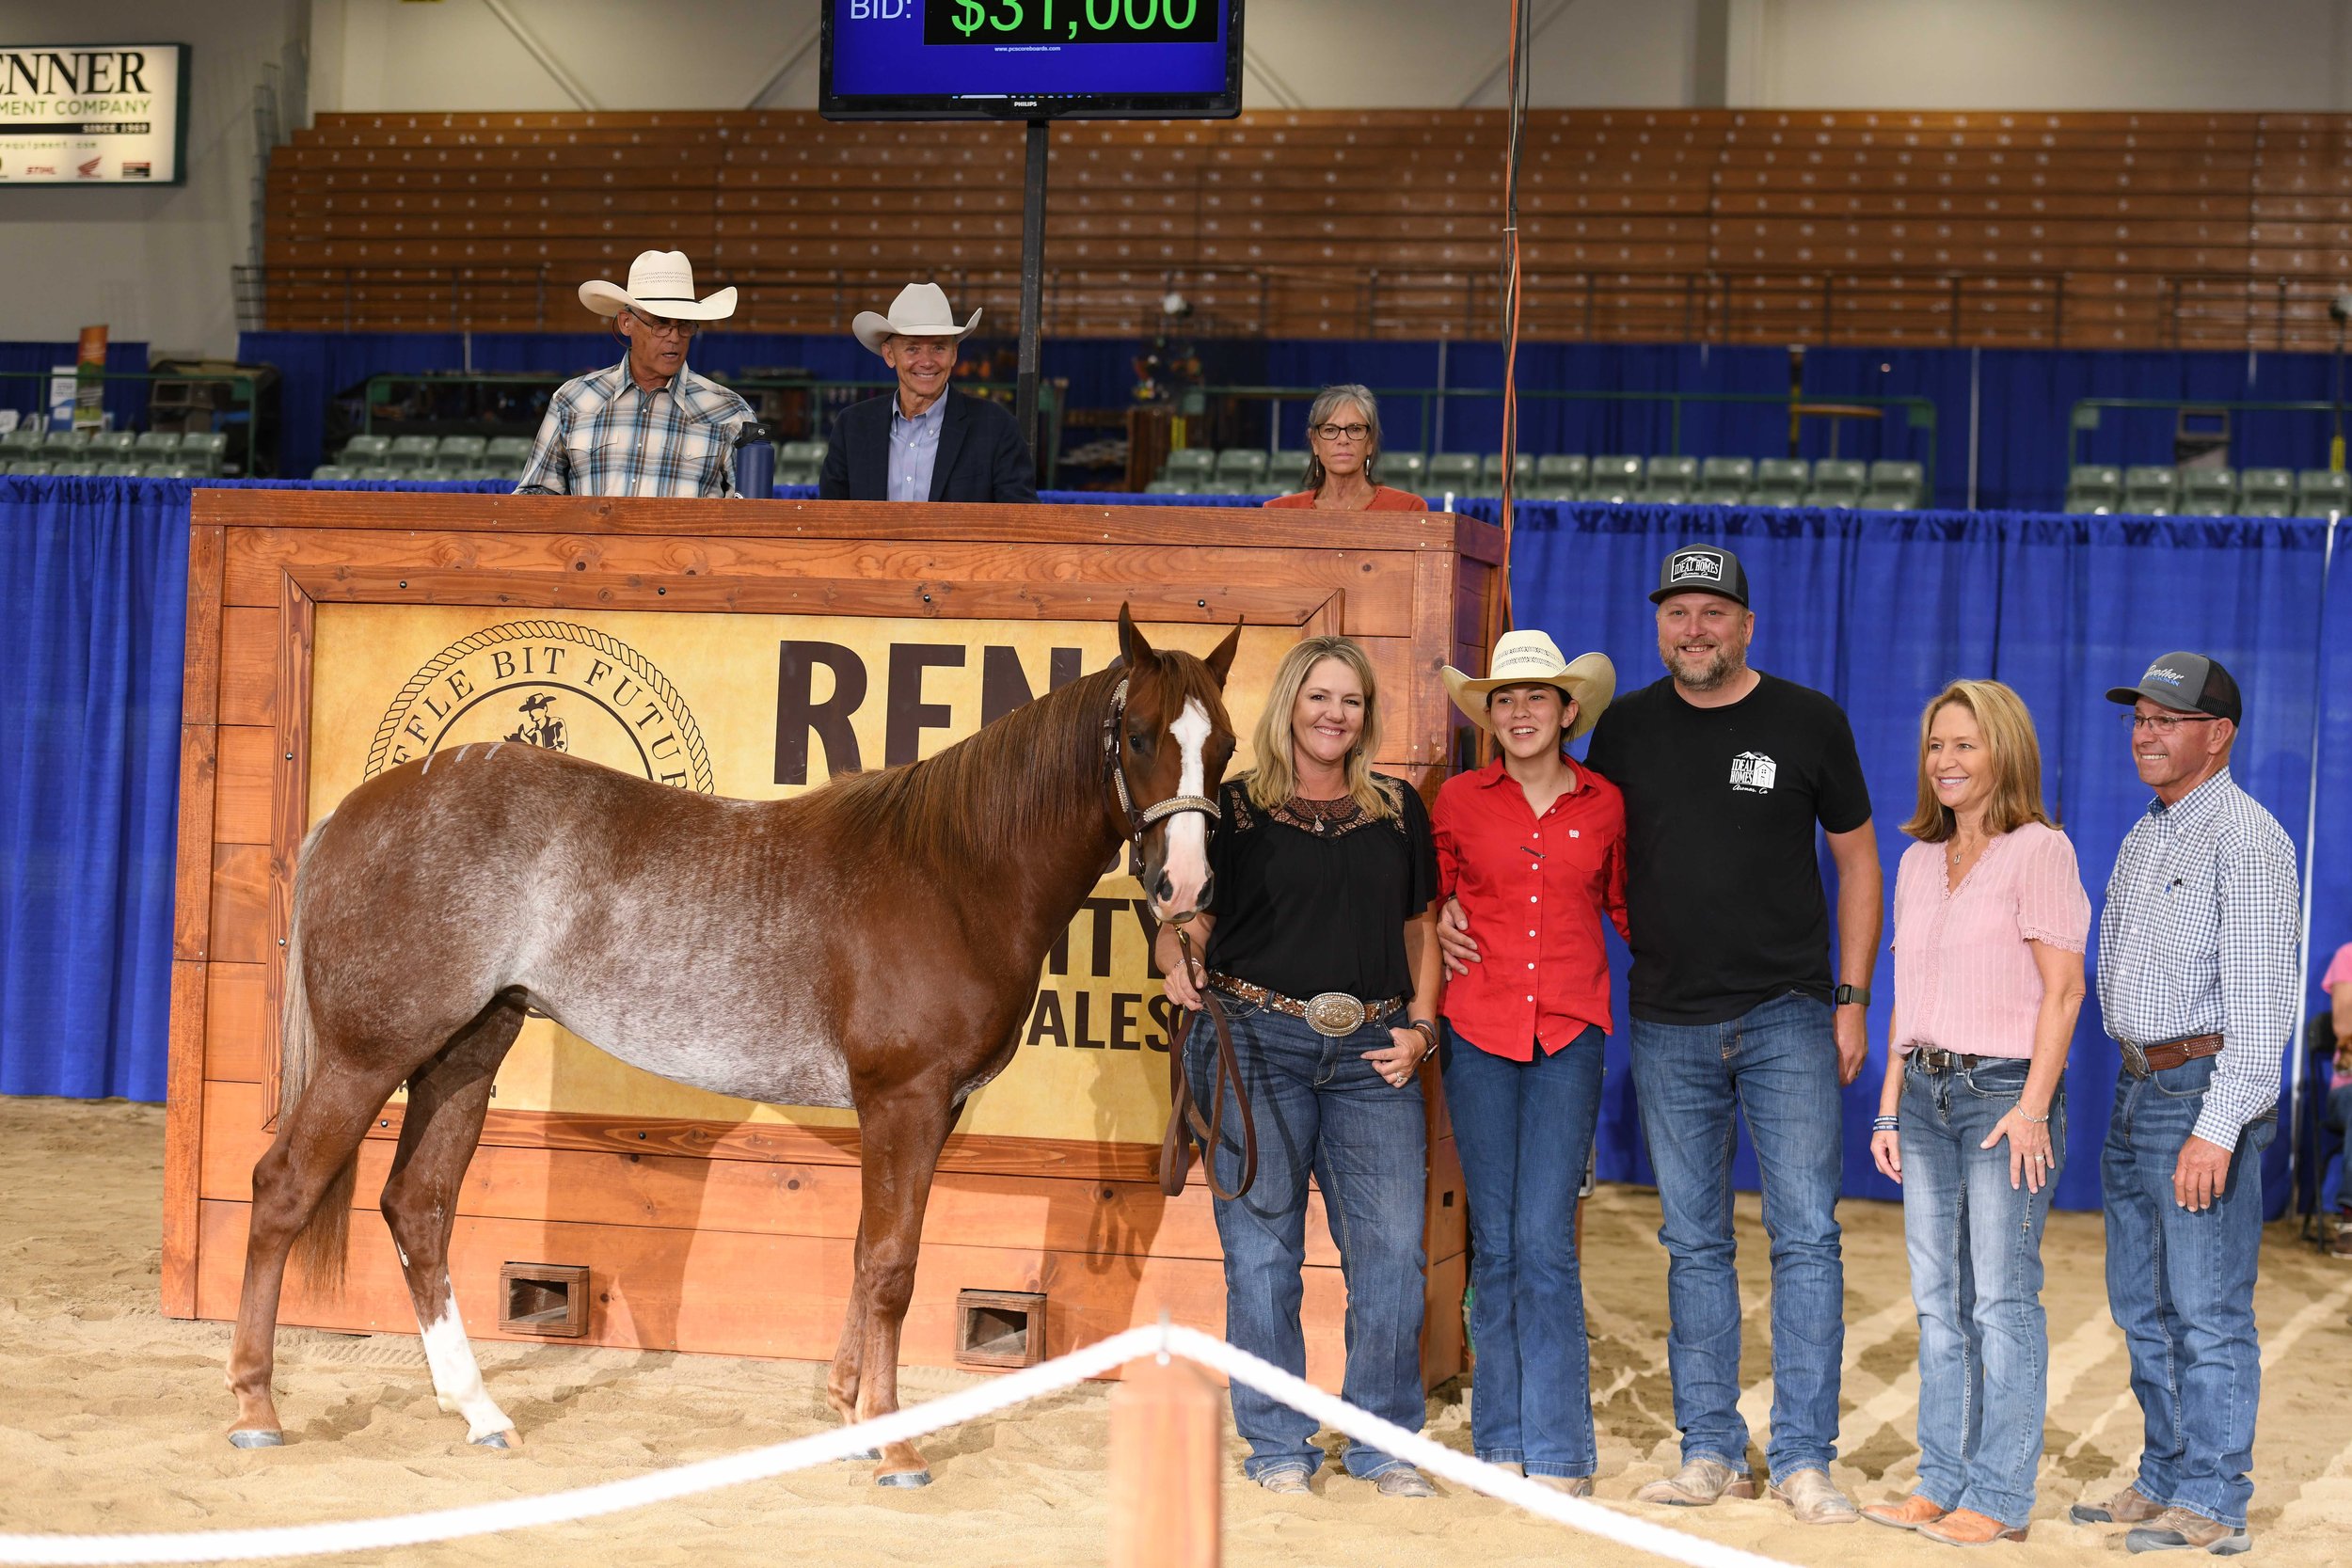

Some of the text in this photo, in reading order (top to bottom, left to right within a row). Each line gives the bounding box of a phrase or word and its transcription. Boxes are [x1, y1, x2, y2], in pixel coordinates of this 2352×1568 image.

[850, 0, 1197, 40] BID: $31,000
[0, 52, 151, 95] NNER
[55, 100, 151, 115] COMPANY
[82, 124, 117, 134] SINCE
[1675, 560, 1693, 574] IDEAL
[1696, 561, 1719, 574] HOMES
[490, 646, 565, 680] BIT
[583, 658, 688, 789] FUTUR
[1732, 759, 1754, 770] IDEAL
[1730, 770, 1754, 784] HOMES
[1026, 990, 1184, 1053] ALES
